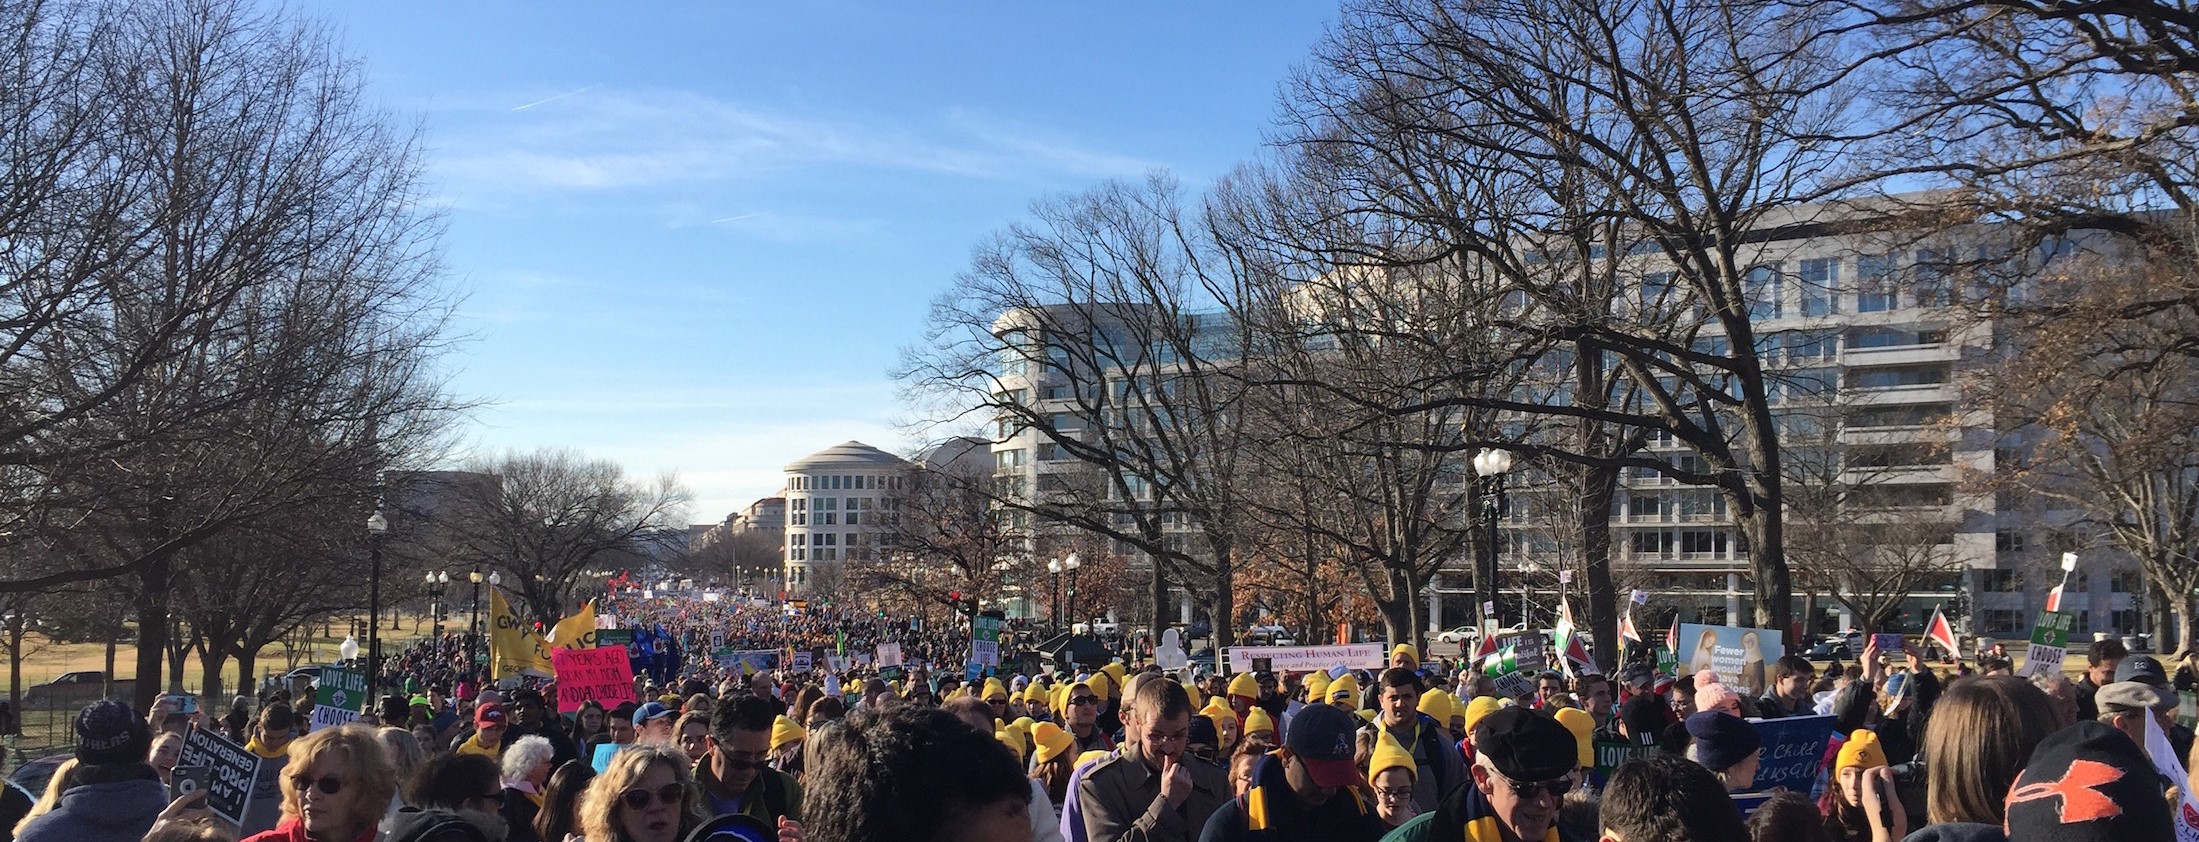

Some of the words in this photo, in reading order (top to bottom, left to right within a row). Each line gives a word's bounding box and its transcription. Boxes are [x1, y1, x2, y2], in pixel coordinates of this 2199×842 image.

[2038, 611, 2058, 628] LOVE
[2056, 614, 2072, 631] LIFE
[975, 641, 996, 653] CHOOSE
[1305, 649, 1345, 658] HUMAN
[1347, 648, 1371, 657] LIFE
[1714, 646, 1744, 656] Fewer
[2031, 646, 2062, 664] CHOOSE
[1658, 650, 1676, 664] LOVE
[1711, 656, 1747, 666] women
[1712, 665, 1743, 674] would
[321, 669, 344, 688] LOVE
[345, 673, 364, 692] LIFE
[1495, 672, 1523, 690] CHOOSE
[318, 706, 354, 726] CHOOSE
[189, 730, 254, 772] GENERATION
[1600, 746, 1632, 767] LOVE
[1774, 741, 1818, 759] Child
[182, 744, 250, 793] PRO-LIFE
[211, 780, 233, 798] AM
[236, 794, 241, 805] I
